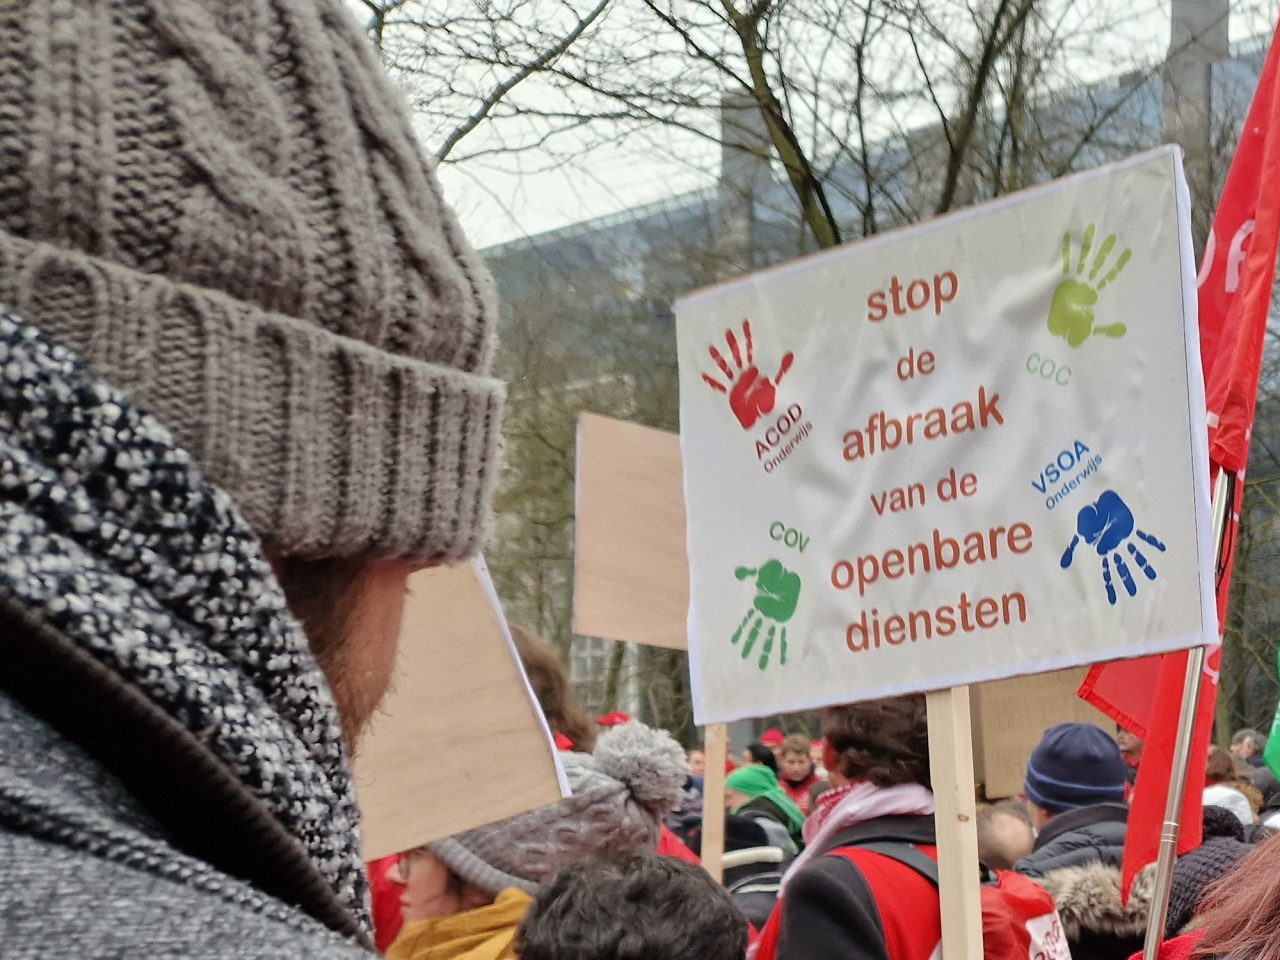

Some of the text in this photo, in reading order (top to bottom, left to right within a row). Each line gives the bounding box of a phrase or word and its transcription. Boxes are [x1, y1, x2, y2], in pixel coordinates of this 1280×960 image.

[866, 271, 959, 322] stop
[896, 348, 936, 381] de
[1026, 353, 1072, 386] COC
[755, 403, 802, 460] ACOD
[764, 420, 813, 473] Onderwijs
[842, 386, 1005, 462] afbraak
[869, 468, 978, 517] van de
[1031, 439, 1090, 494] VSOA
[1045, 454, 1103, 510] Onderwijs
[769, 521, 810, 553] COV
[830, 521, 1034, 597] openbare
[845, 591, 1028, 654] diensten
